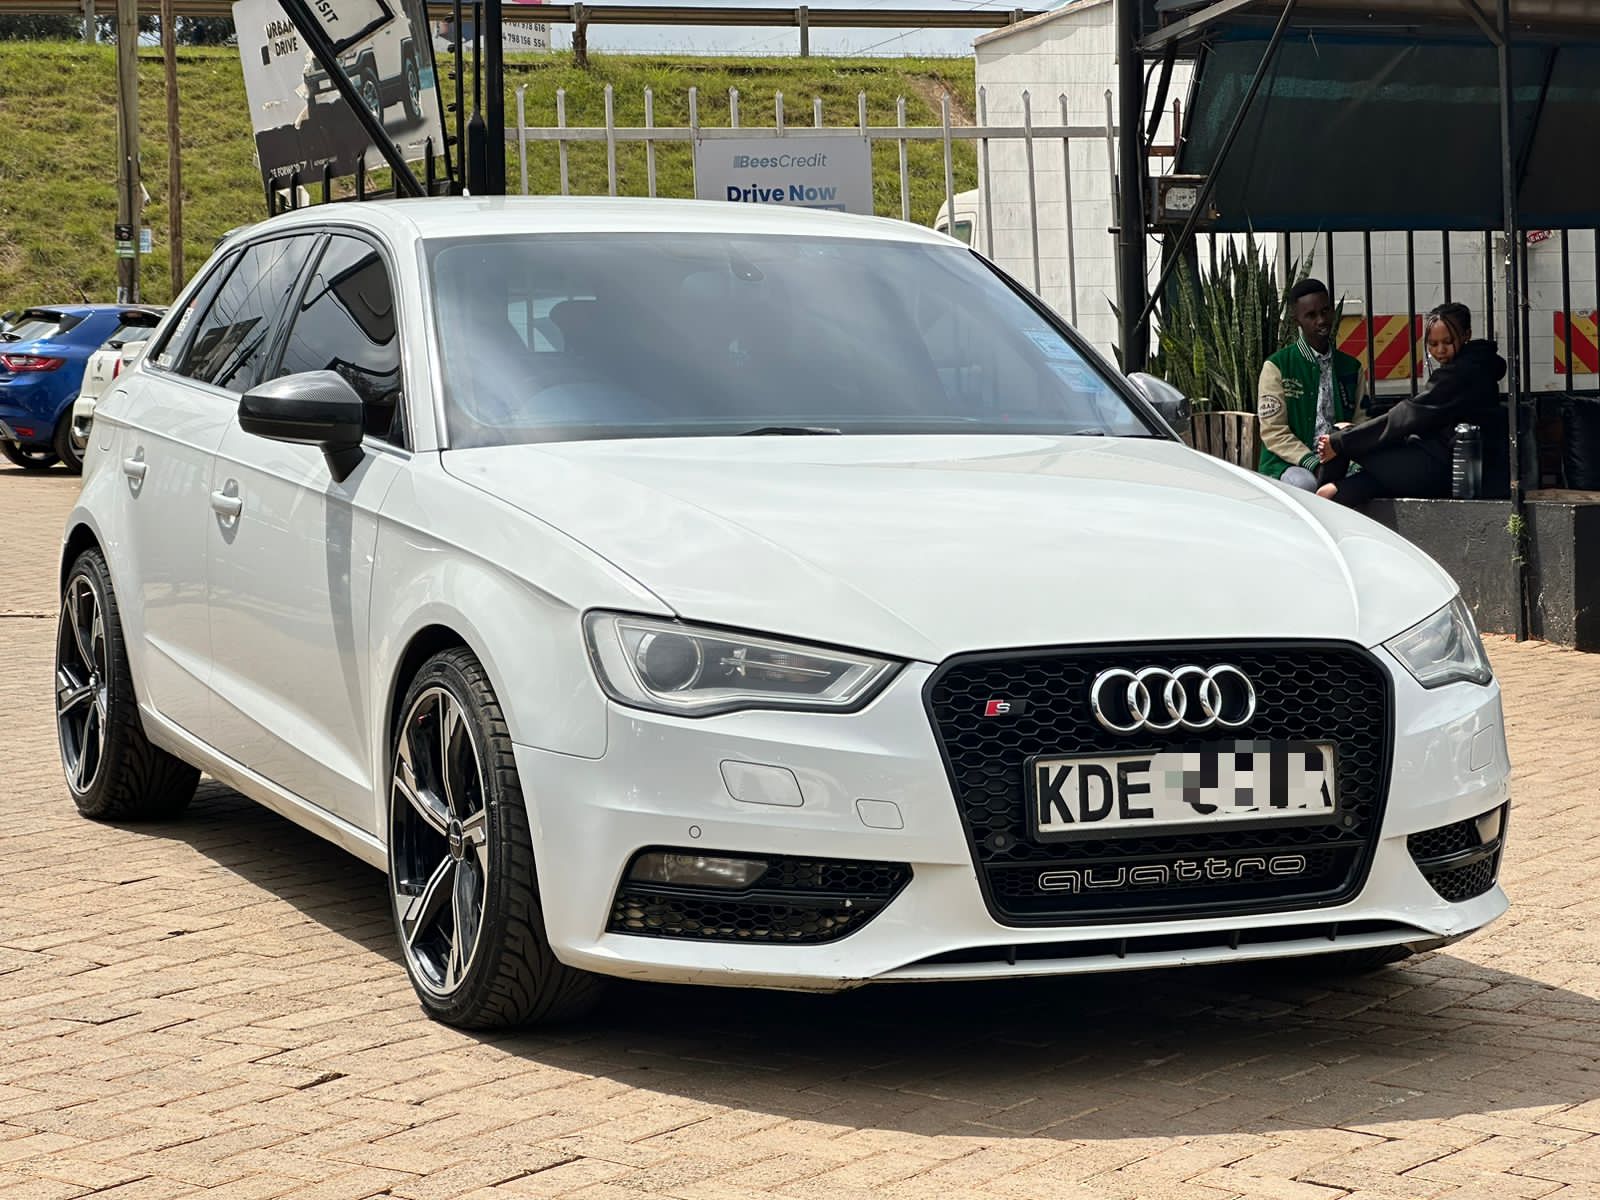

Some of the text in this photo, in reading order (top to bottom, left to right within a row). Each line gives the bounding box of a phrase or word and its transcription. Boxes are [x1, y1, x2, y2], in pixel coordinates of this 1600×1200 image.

[265, 19, 294, 39] URBAN
[275, 37, 298, 56] DRIVE
[739, 153, 827, 169] BeesCredit
[727, 184, 837, 203] Drive Now
[1038, 760, 1154, 825] KDE
[1039, 855, 1306, 894] quattro
